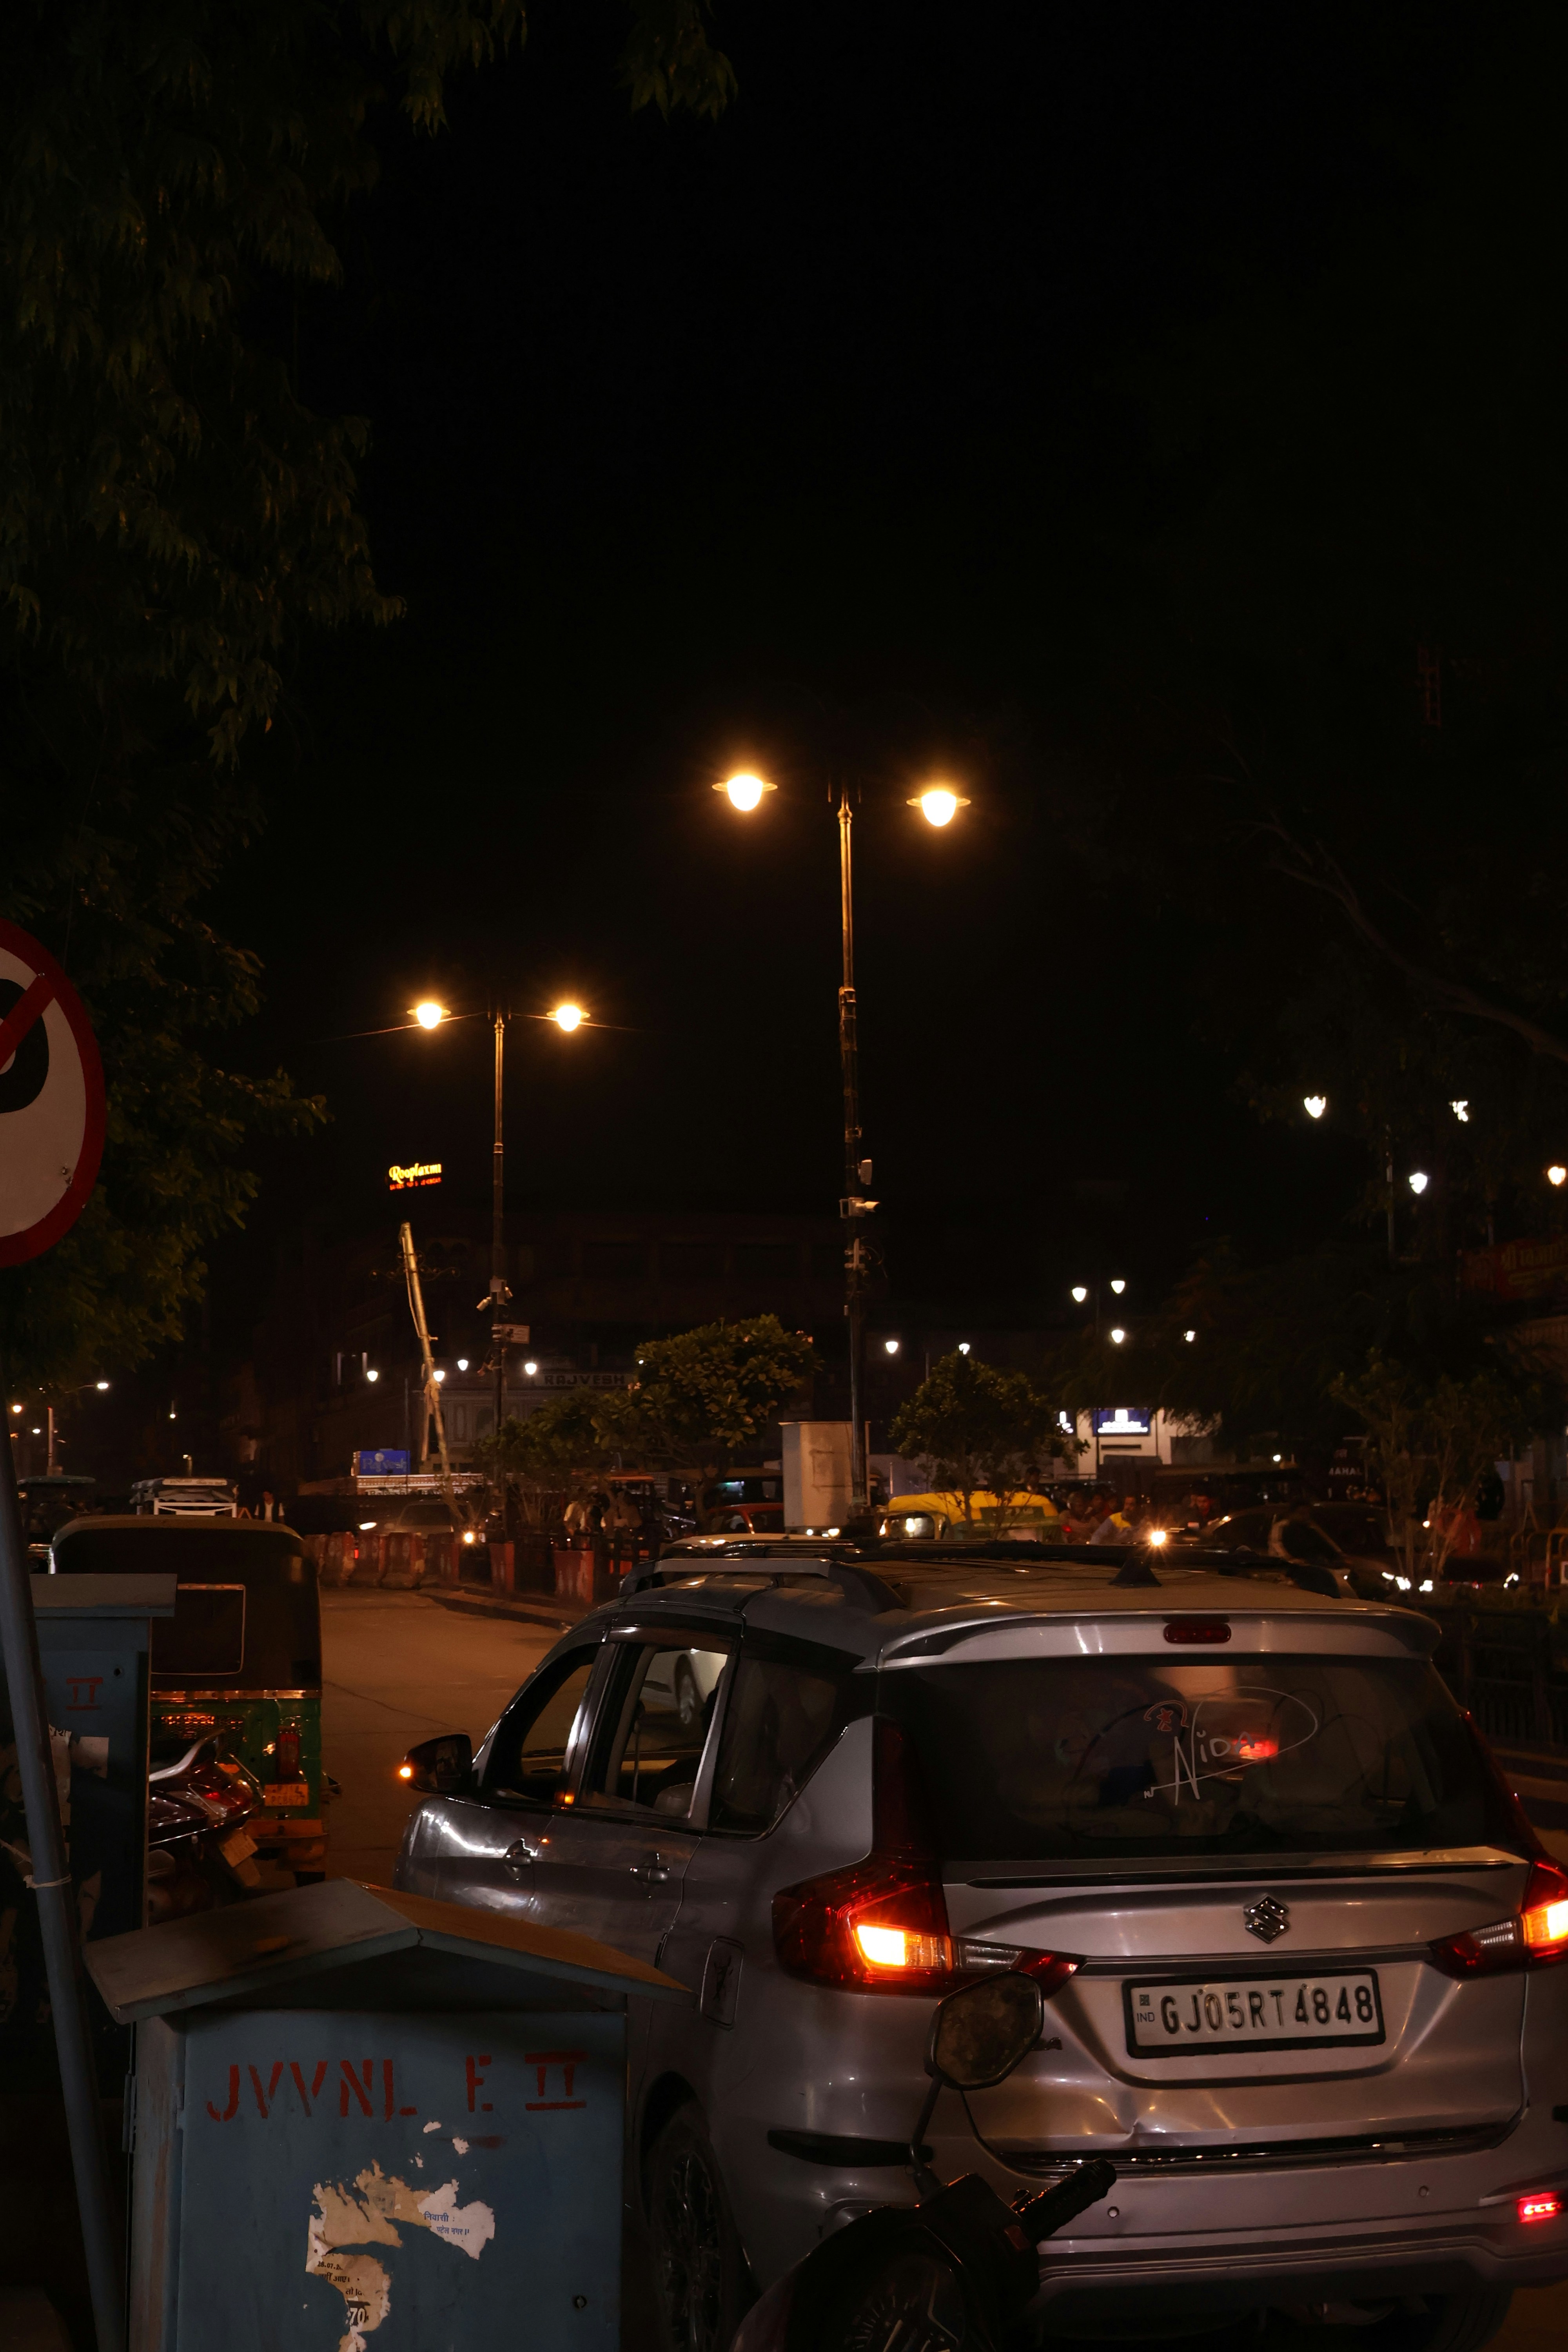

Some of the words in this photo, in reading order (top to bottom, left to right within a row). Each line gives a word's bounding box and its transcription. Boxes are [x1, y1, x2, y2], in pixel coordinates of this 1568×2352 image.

[544, 1375, 624, 1385] RAJVESH
[1137, 2012, 1154, 2023] IND
[206, 2059, 417, 2122] JVVNL
